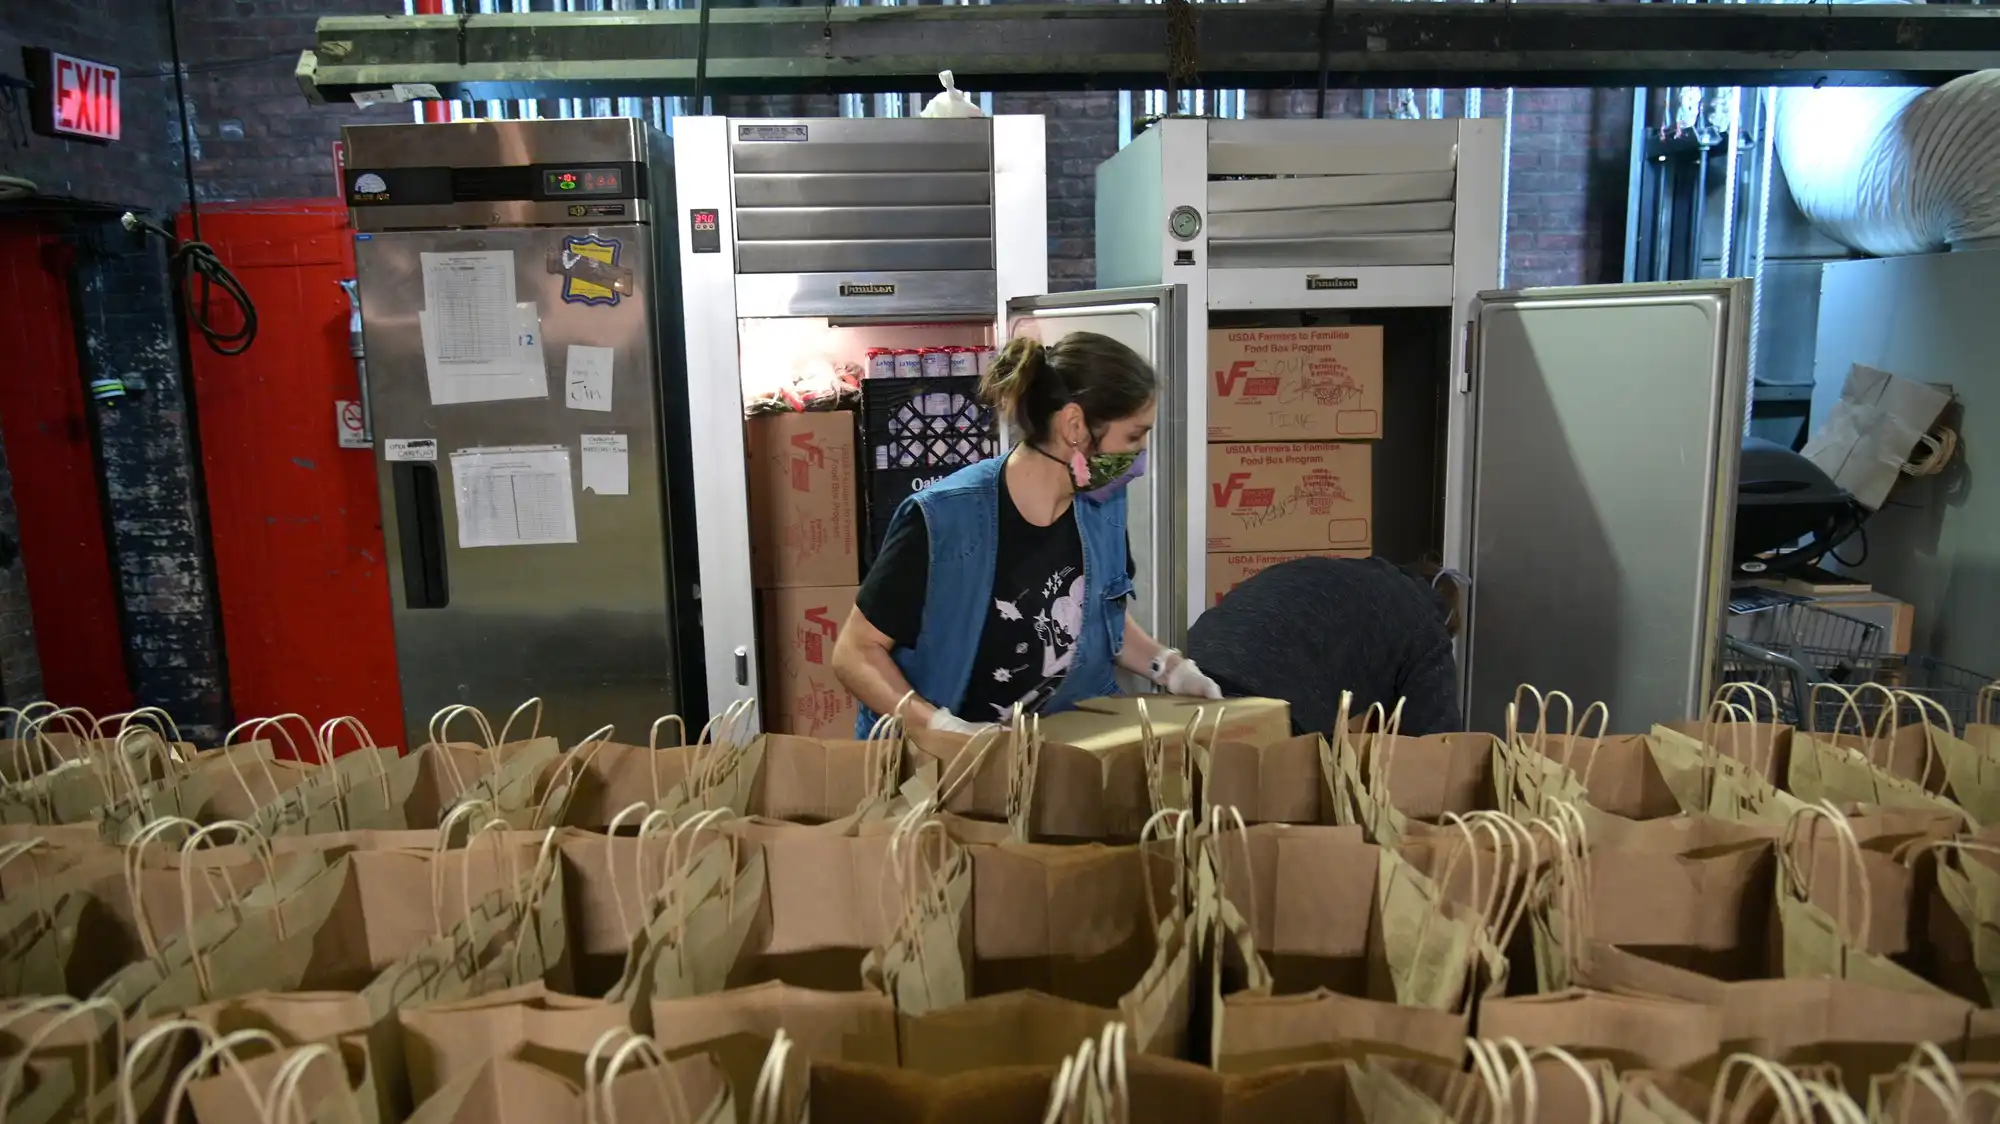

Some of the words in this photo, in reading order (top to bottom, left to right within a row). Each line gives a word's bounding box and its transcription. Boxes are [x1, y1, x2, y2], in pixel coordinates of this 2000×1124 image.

[57, 59, 116, 135] EXIT
[1228, 332, 1256, 342] USDA
[1258, 332, 1297, 341] Farmers
[1300, 332, 1307, 340] to
[1311, 331, 1350, 340] Families
[1244, 344, 1268, 353] Food
[1271, 344, 1289, 353] Box
[1292, 343, 1332, 354] Program
[1215, 361, 1256, 397] VF
[1225, 445, 1252, 454] USDA
[1254, 444, 1291, 453] Farmers
[1293, 444, 1301, 452] to
[1304, 443, 1341, 452] Families
[1241, 456, 1264, 465] Food
[1266, 456, 1283, 464] Box
[1286, 456, 1324, 466] Program
[1212, 473, 1252, 508] VF
[1228, 555, 1254, 564] USDA
